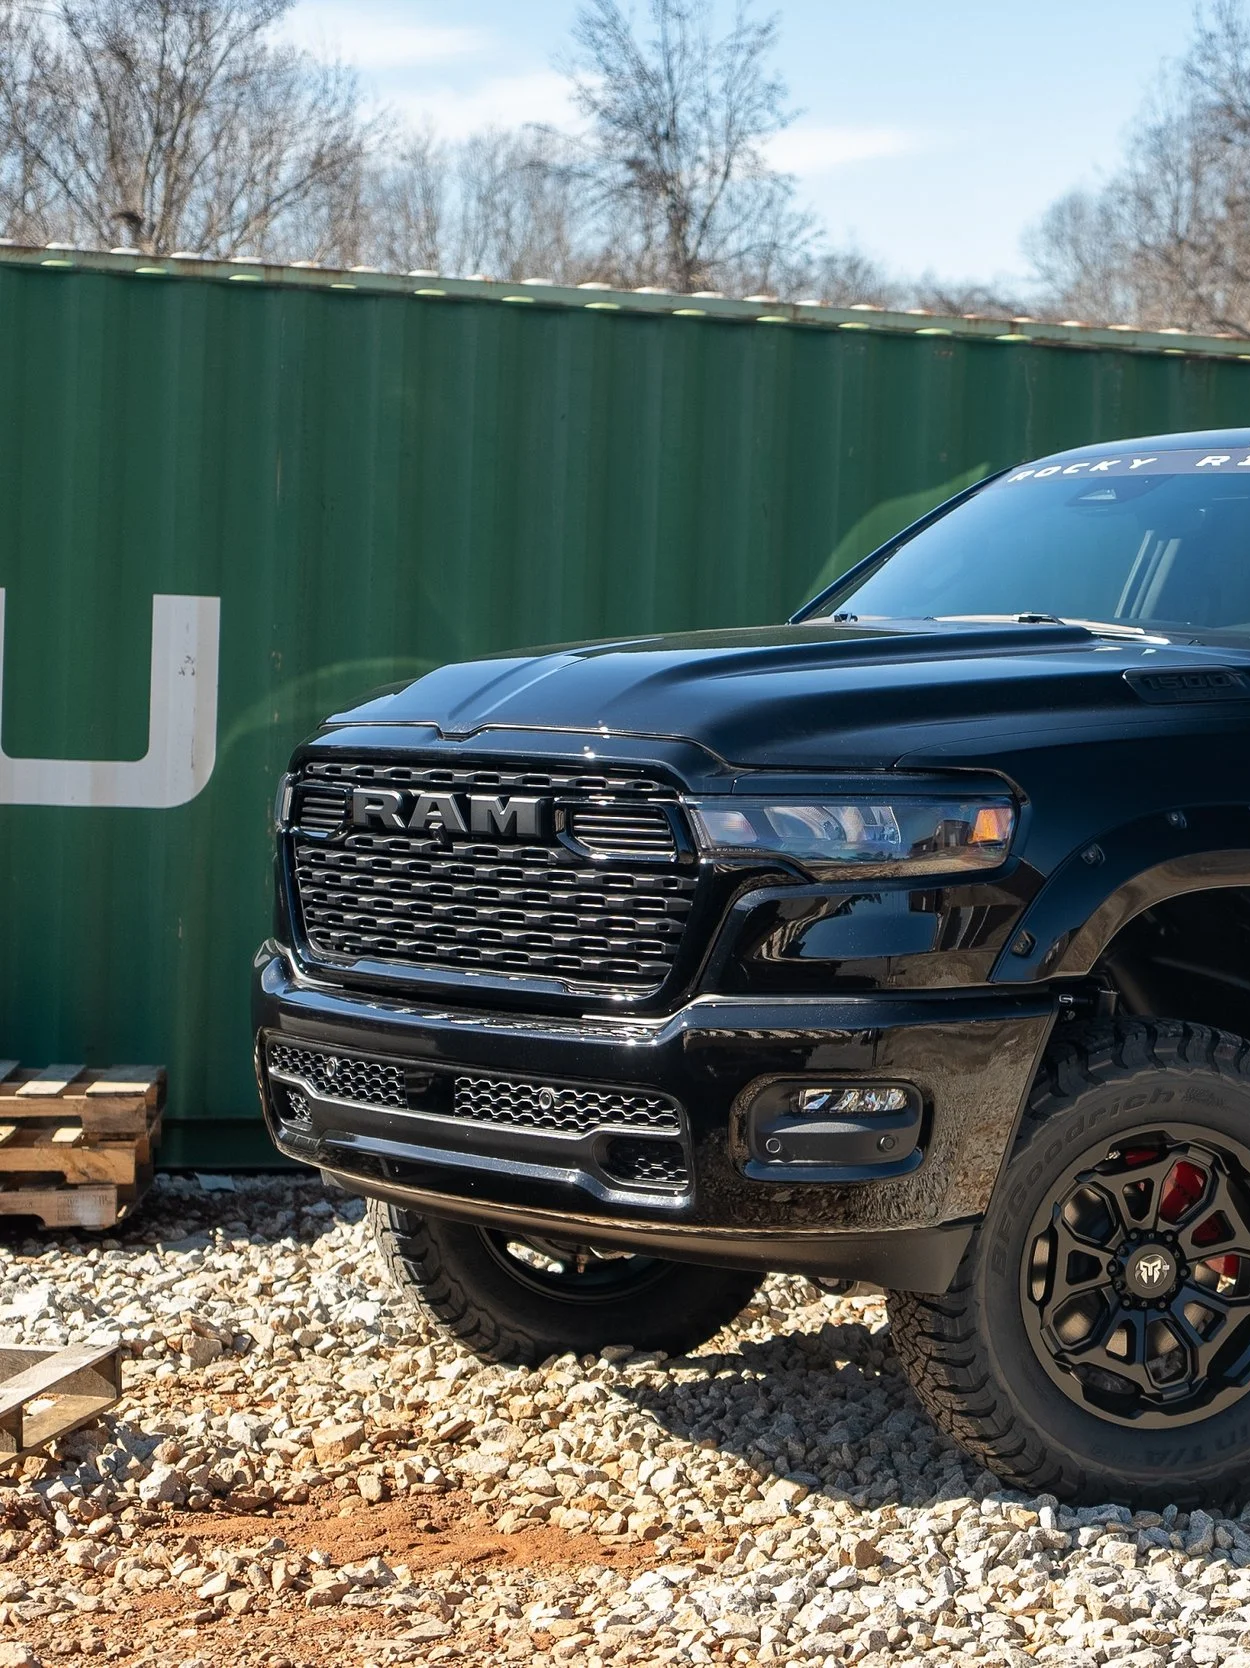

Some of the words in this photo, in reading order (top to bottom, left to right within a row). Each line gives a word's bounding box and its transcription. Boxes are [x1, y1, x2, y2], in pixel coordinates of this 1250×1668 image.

[1007, 457, 1158, 482] ROCKY
[1143, 673, 1232, 690] 1500
[352, 787, 550, 838] RAM
[991, 1087, 1176, 1278] BFGoodrich
